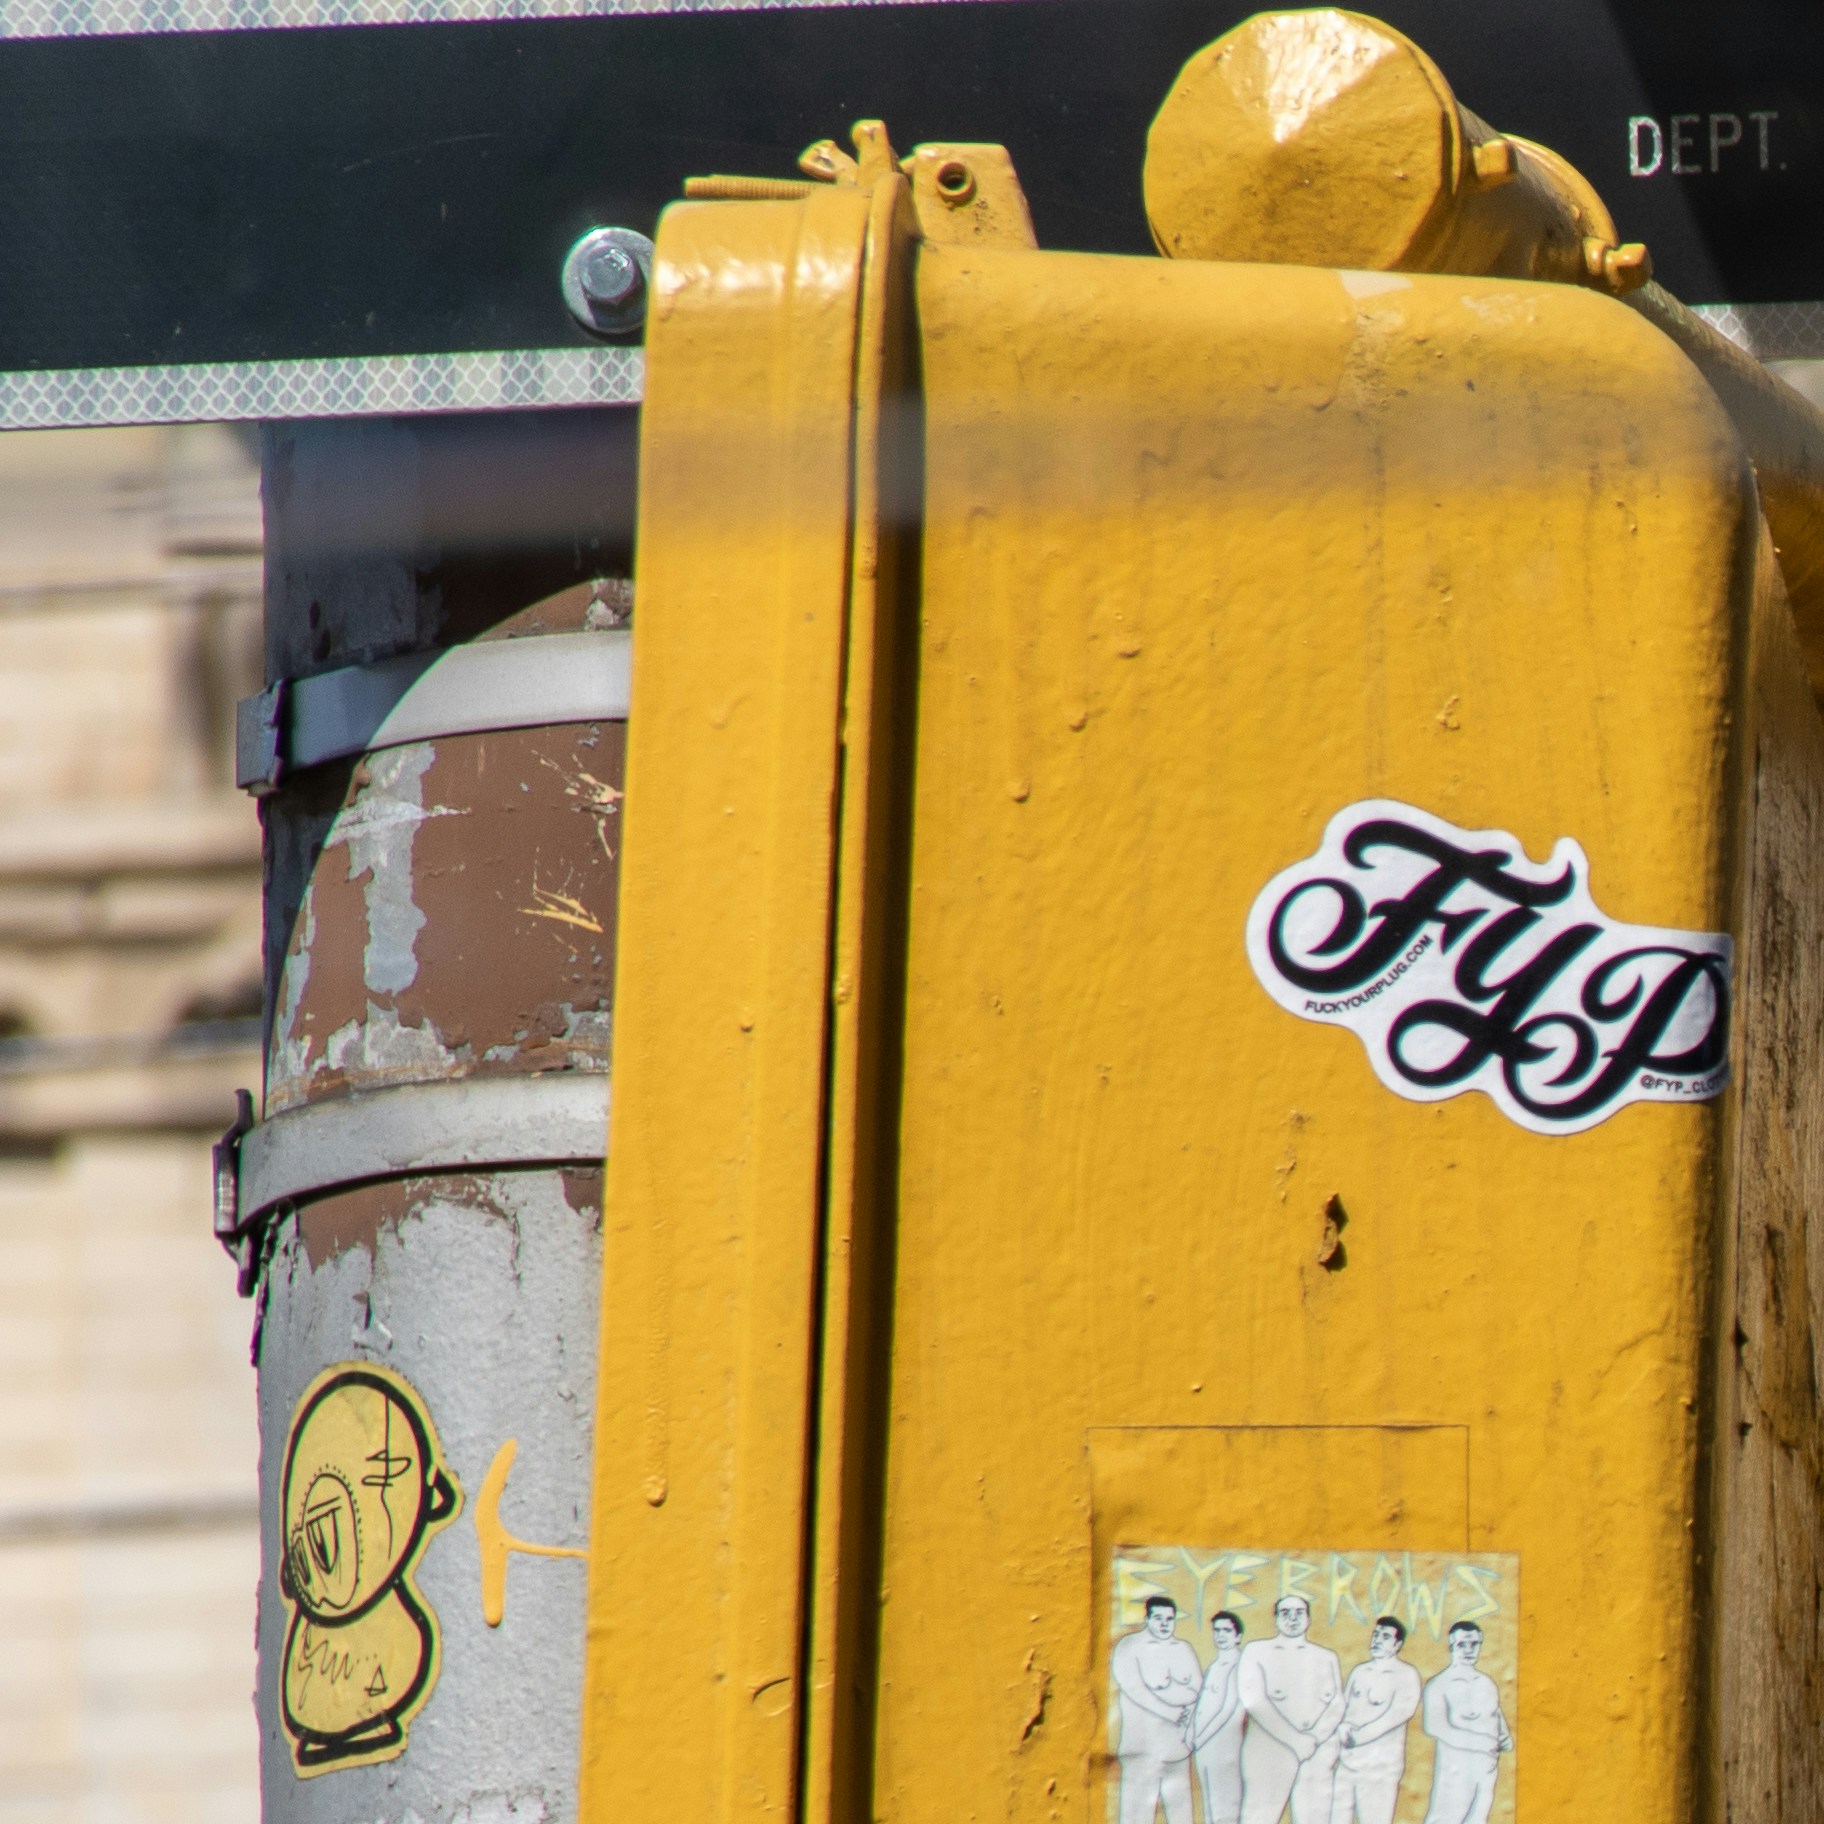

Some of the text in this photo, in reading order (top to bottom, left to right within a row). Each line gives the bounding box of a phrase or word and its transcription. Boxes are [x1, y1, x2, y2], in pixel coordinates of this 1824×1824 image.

[1627, 110, 1788, 178] DEPT.
[1267, 818, 1728, 1122] FYP
[1304, 934, 1434, 1014] FUCKYOURPLUG.COM
[1115, 1547, 1503, 1643] EYEBROWS
